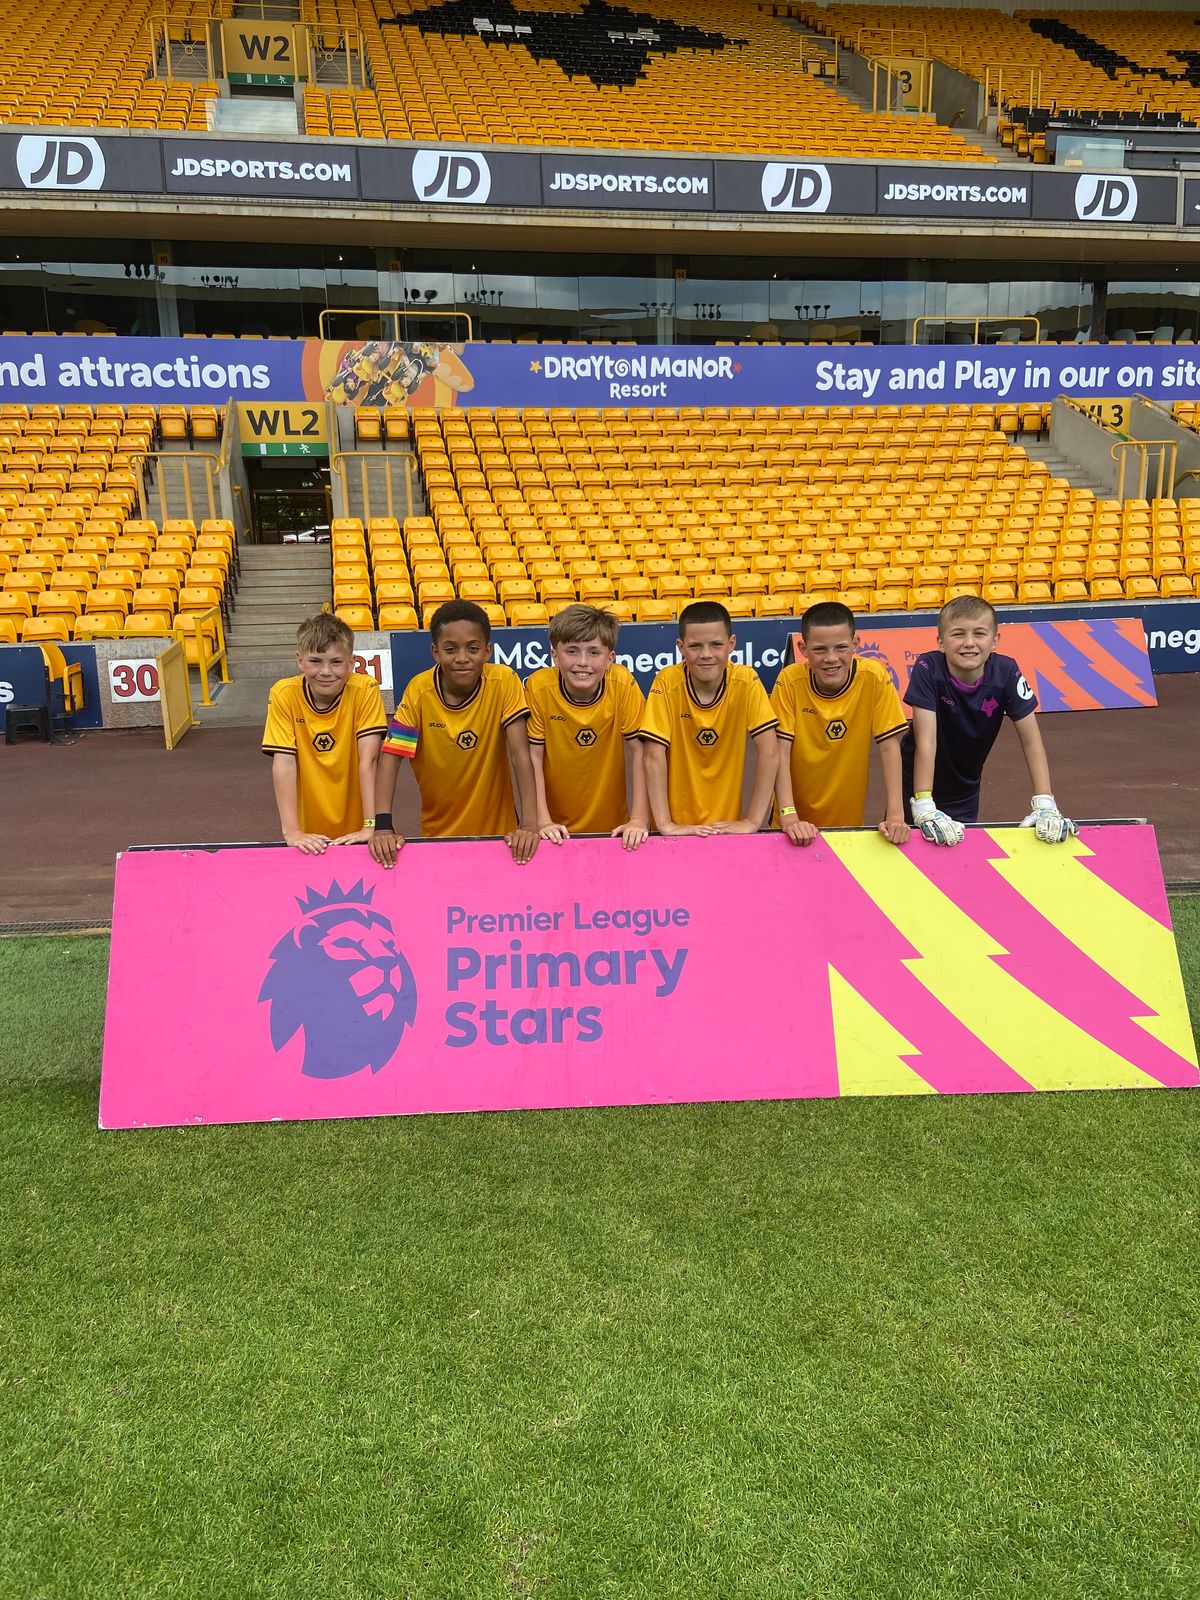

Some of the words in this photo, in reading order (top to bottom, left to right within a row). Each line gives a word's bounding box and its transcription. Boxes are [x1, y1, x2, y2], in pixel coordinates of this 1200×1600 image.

[239, 34, 290, 62] W2
[30, 141, 93, 185] JD
[171, 158, 352, 182] JDSPORTS.COM
[424, 156, 480, 198] JD
[549, 172, 709, 194] JDSPORTS.COM
[771, 168, 822, 208] JD
[883, 183, 1027, 204] JDSPORTS.COM
[1083, 179, 1130, 217] JD
[0, 353, 46, 387] nd
[58, 355, 271, 389] attractions
[815, 360, 881, 398] Stay
[888, 360, 946, 390] and
[954, 360, 1017, 397] Play
[1024, 359, 1051, 388] in
[1059, 366, 1110, 388] our
[1116, 366, 1154, 388] on
[1161, 358, 1200, 387] sit
[610, 381, 668, 400] Resort
[246, 409, 320, 436] WL2
[1144, 629, 1200, 654] neg
[112, 663, 159, 698] 30
[447, 905, 565, 934] Premier
[573, 902, 690, 936] League
[447, 939, 689, 997] Primary
[444, 1000, 604, 1047] Stars
